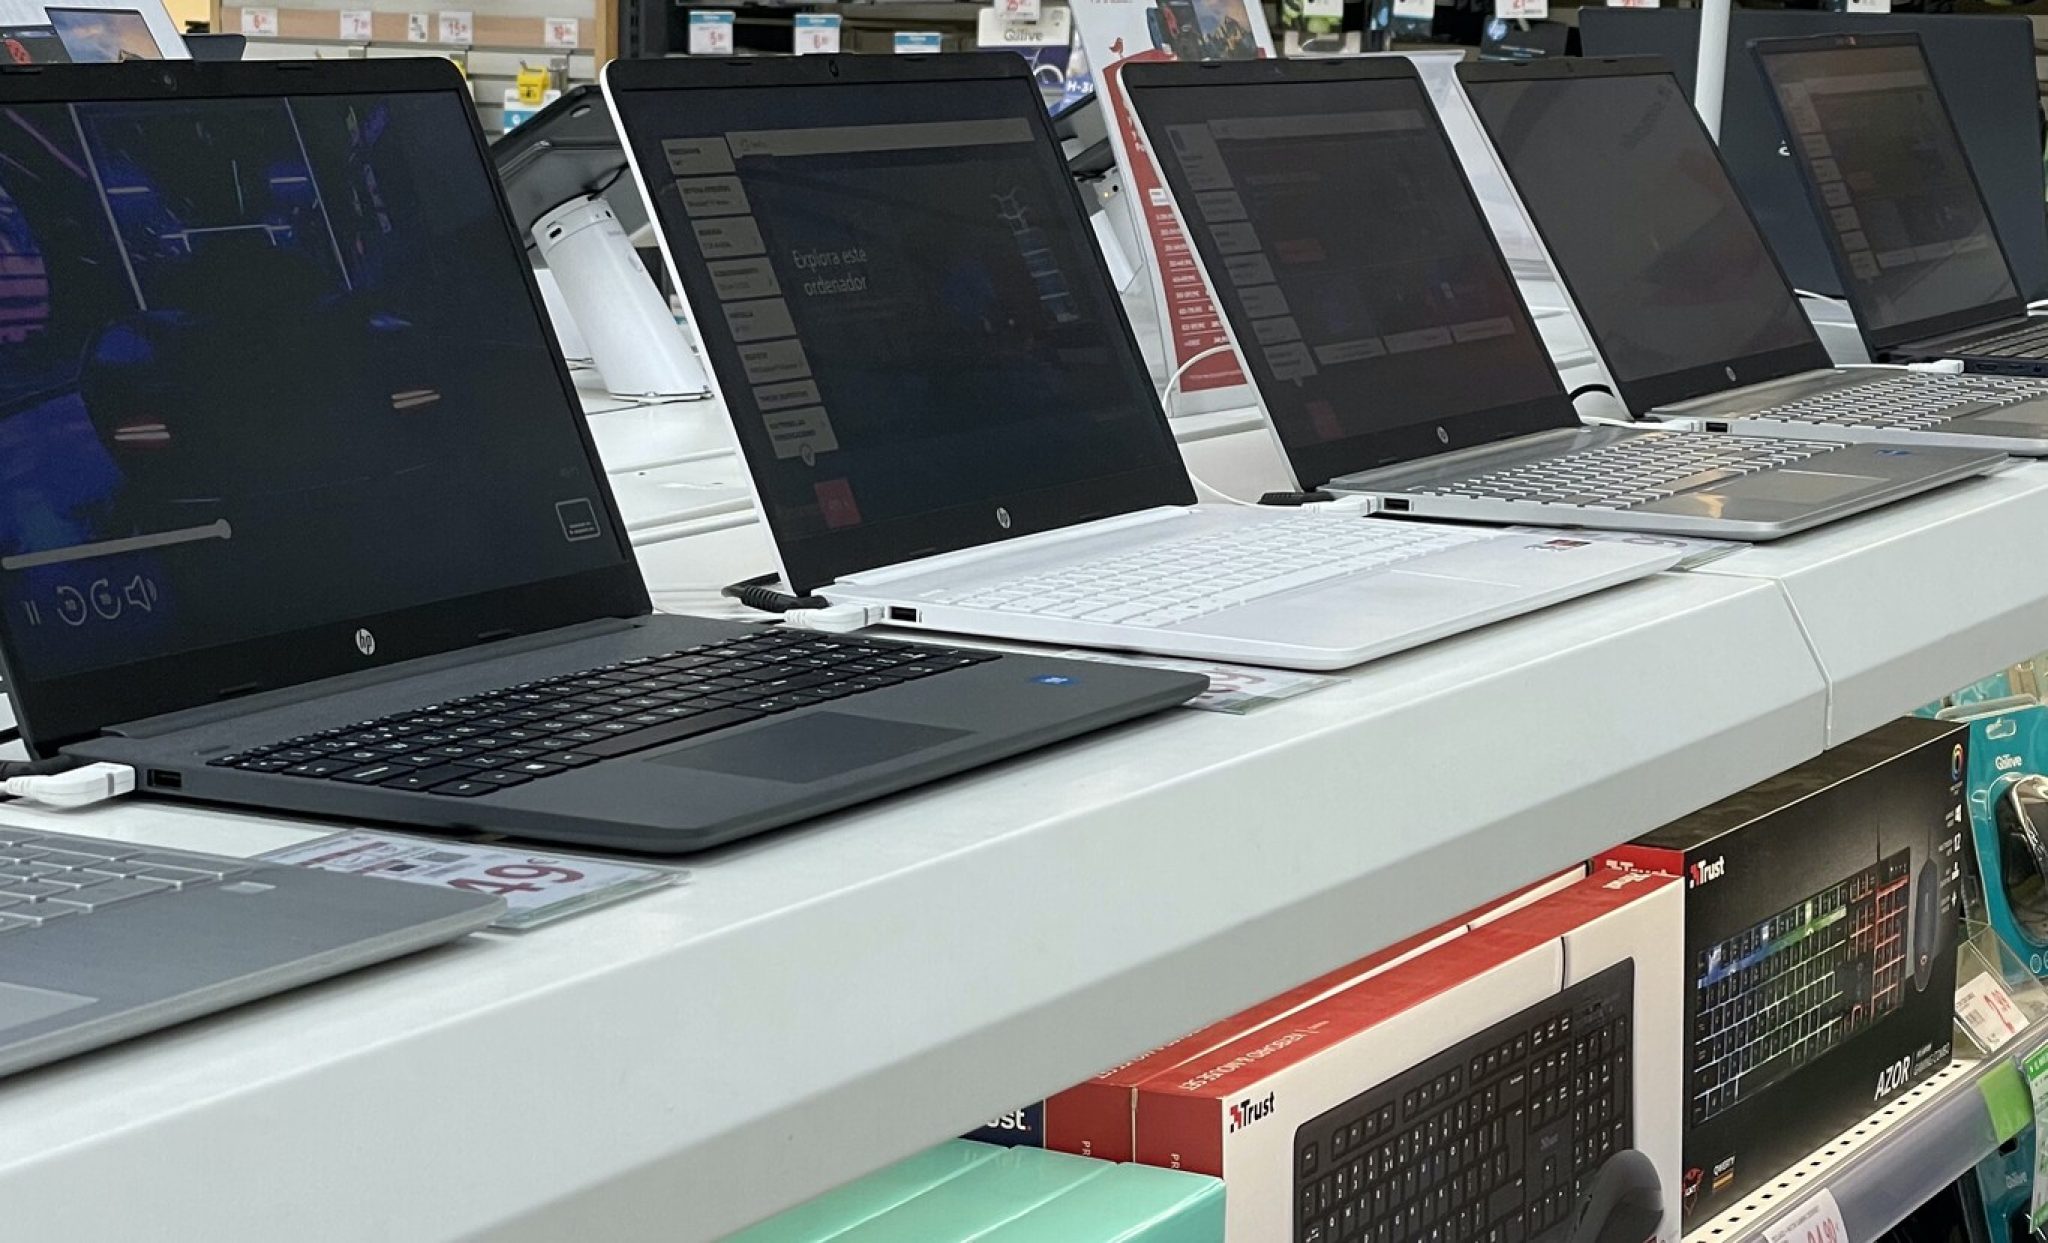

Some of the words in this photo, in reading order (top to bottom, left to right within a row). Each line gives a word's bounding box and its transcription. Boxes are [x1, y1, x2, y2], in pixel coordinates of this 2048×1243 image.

[792, 248, 840, 272] Explora
[841, 246, 867, 264] este
[804, 273, 868, 296] ordenador
[355, 627, 376, 656] hp
[1697, 856, 1725, 884] Trust
[1874, 1056, 1911, 1101] AZOR
[1241, 1091, 1275, 1127] Trust
